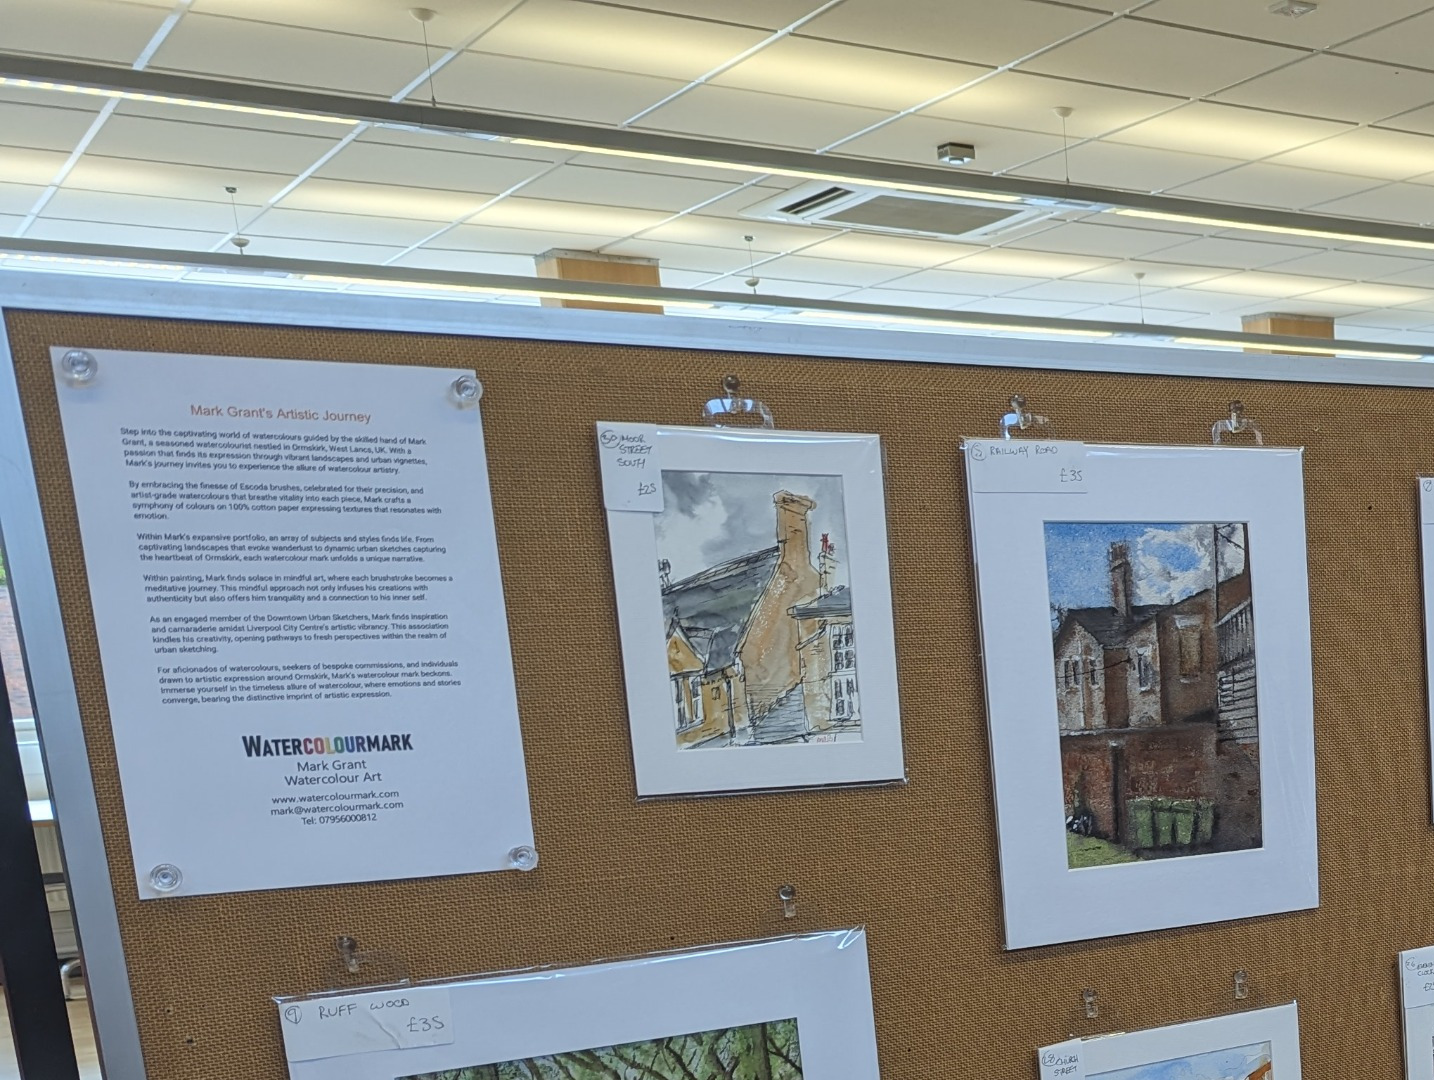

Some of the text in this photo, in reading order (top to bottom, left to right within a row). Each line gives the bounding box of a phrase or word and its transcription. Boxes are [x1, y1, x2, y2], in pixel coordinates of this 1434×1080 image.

[190, 404, 371, 424] Mark Grant's Artistic Journey
[120, 426, 426, 445] Step into the captivating world of watercolours guided by the skilled hand of Mark
[621, 434, 646, 443] MOOR
[121, 437, 146, 447] Grant,
[154, 438, 194, 447] seasoned
[195, 439, 252, 449] watercolourist
[252, 441, 282, 450] nestled
[282, 442, 290, 450] in
[291, 443, 327, 453] Ormskirk,
[328, 444, 348, 452] West
[348, 445, 373, 454] Lancs,
[374, 445, 387, 453] UK.
[388, 446, 405, 454] With
[618, 444, 653, 455] STREET
[990, 445, 1029, 458] RAILWAY
[1035, 445, 1059, 455] ROAD
[123, 447, 427, 466] passion that finds its expression through vibrant landscapes and urban vignettes,
[616, 458, 646, 469] SOUTH
[124, 458, 152, 467] Mark's
[153, 459, 184, 470] journey
[184, 460, 211, 468] invites
[212, 462, 227, 471] you
[228, 461, 237, 469] to
[238, 461, 280, 472] experience
[281, 463, 294, 471] the
[295, 463, 316, 471] allure
[327, 464, 371, 473] watercolour
[372, 465, 399, 475] artistry.
[1059, 467, 1083, 483] £35
[637, 481, 657, 496] £25
[136, 532, 162, 540] Within
[163, 532, 190, 540] Mark's
[191, 532, 231, 542] expansive
[231, 533, 267, 543] portfolio,
[280, 535, 299, 543] array
[299, 533, 309, 541] of
[310, 534, 341, 543] subjects
[342, 534, 357, 542] and
[358, 534, 380, 544] styles
[380, 534, 399, 542] finds
[138, 542, 183, 552] captivating
[183, 542, 229, 553] landscapes
[229, 543, 246, 551] that
[247, 543, 270, 551] evoke
[271, 543, 313, 551] wanderlust
[323, 544, 355, 553] dynamic
[378, 544, 411, 552] sketches
[412, 544, 446, 554] capturing
[139, 552, 153, 560] the
[153, 552, 193, 561] heartbeat
[194, 553, 203, 561] of
[204, 553, 242, 562] Ormskirk,
[242, 553, 262, 561] each
[262, 553, 308, 561] watercolour
[308, 553, 328, 561] mark
[365, 554, 390, 563] unique
[157, 665, 170, 673] For
[171, 664, 217, 673] aficionados
[218, 664, 228, 672] of
[228, 663, 280, 673] watercolours,
[281, 662, 311, 670] seekers
[312, 662, 321, 670] of
[321, 661, 353, 671] bespoke
[354, 660, 405, 670] commissions,
[420, 659, 458, 667] individuals
[158, 669, 452, 684] drawn to artistic expression around Ormskirk, Mark's watercolour mark beckons.
[296, 758, 366, 772] Mark Grant
[284, 771, 381, 786] Watercolour Art
[271, 789, 399, 804] www.watercolourmark.com
[270, 800, 403, 816] mark@watercolourmark.com
[301, 812, 376, 825] Tel: 07956000812
[319, 1003, 357, 1020] RUFF
[369, 998, 410, 1011] WOOD
[406, 1016, 445, 1033] £35
[1055, 1054, 1079, 1065] CHURCH
[1054, 1065, 1077, 1077] STREET
